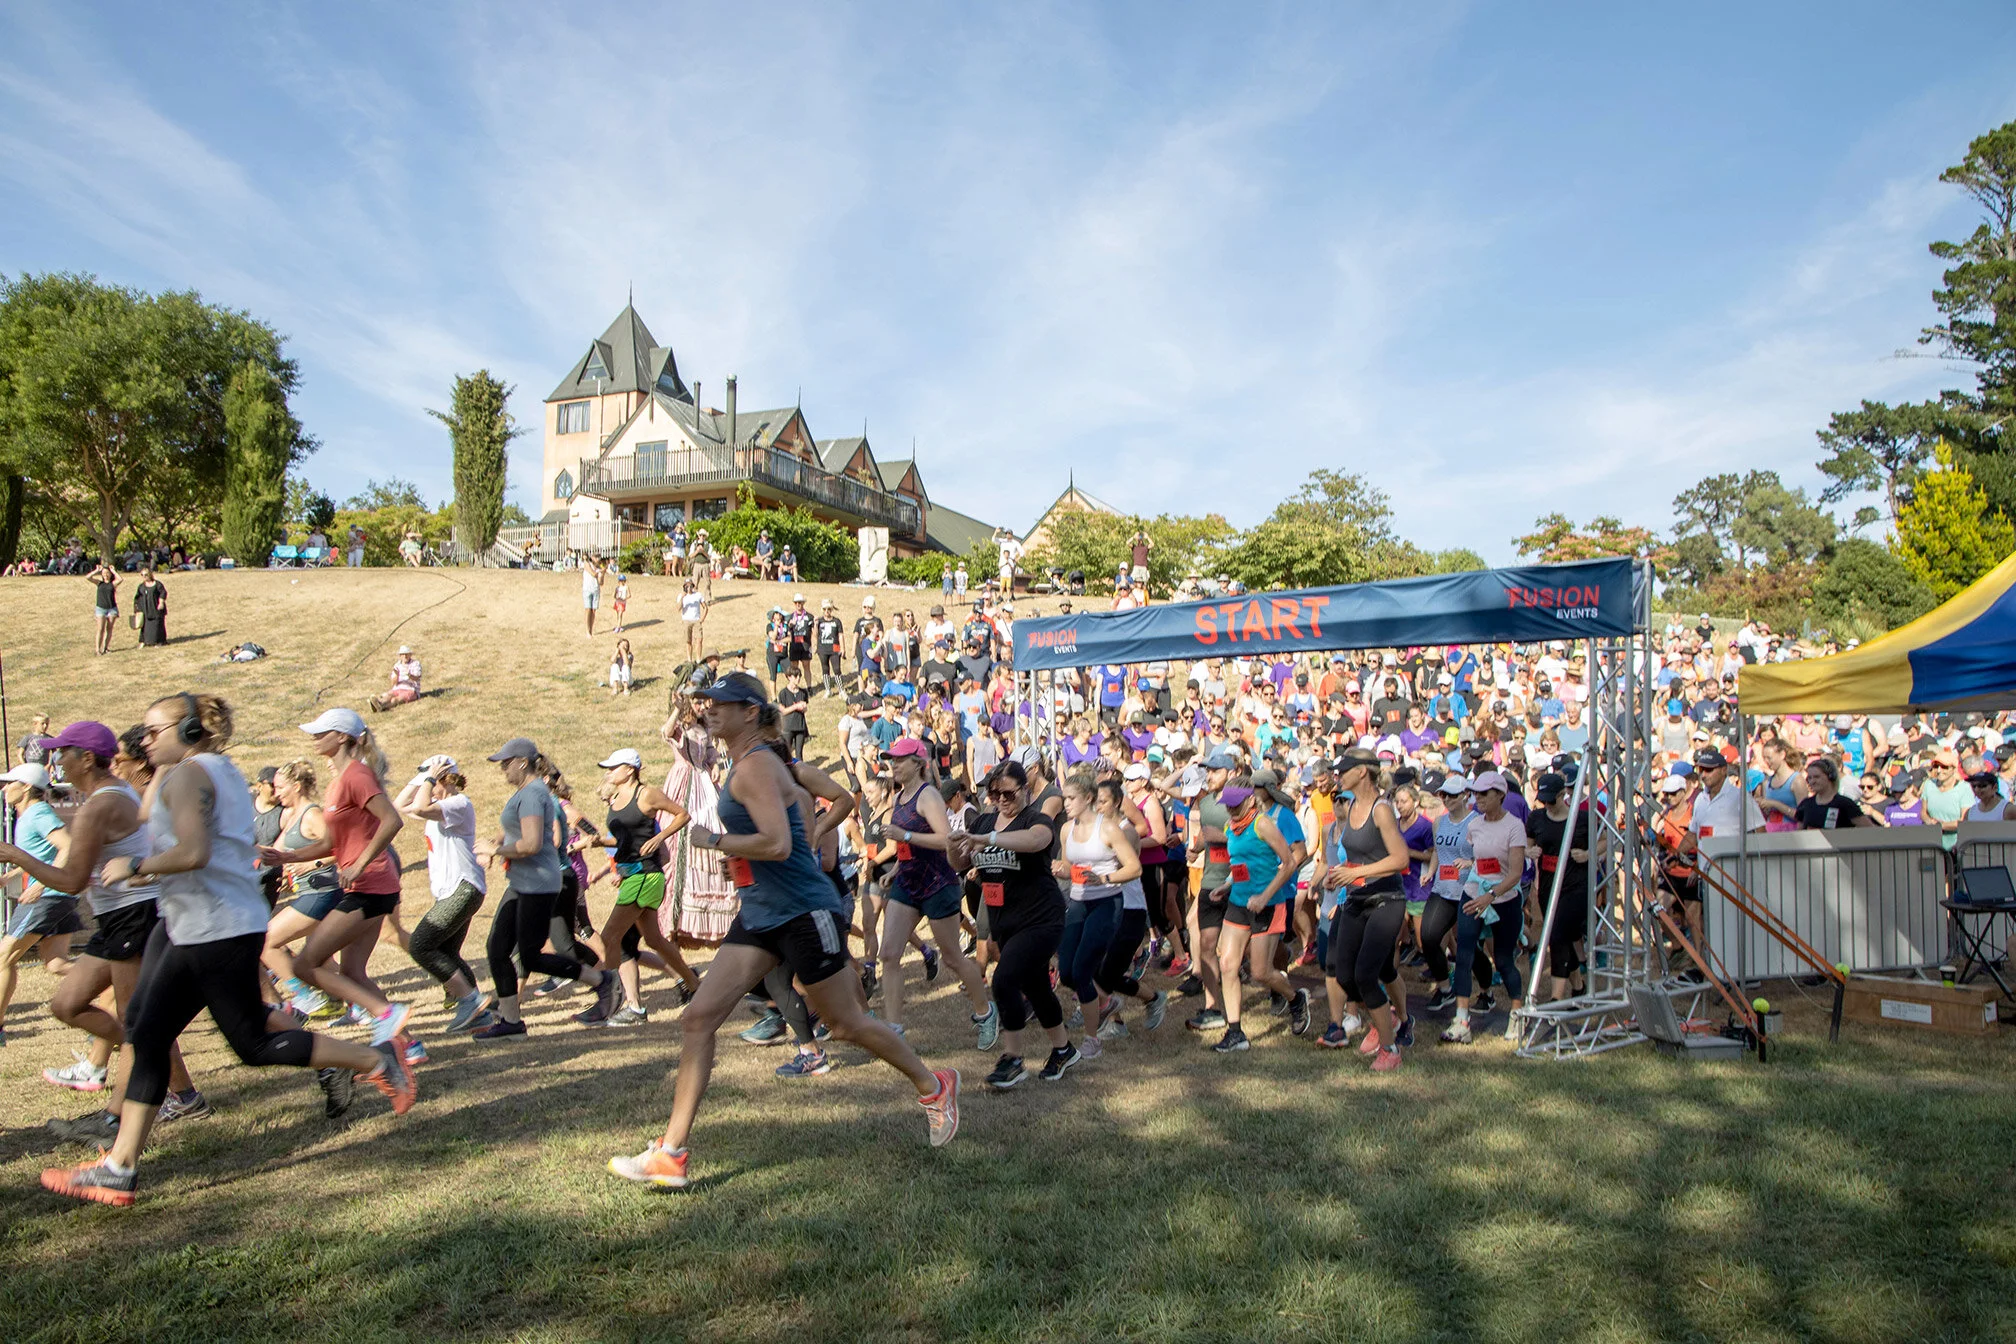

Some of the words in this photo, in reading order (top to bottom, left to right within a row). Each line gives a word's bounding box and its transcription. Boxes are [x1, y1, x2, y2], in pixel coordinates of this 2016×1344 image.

[1504, 585, 1600, 609] FUSION
[1194, 596, 1330, 645] START
[1556, 607, 1598, 619] EVENTS
[1027, 628, 1077, 649] FUSION
[1054, 645, 1077, 654] EVENTS
[1436, 832, 1461, 846] oui
[973, 850, 1017, 867] NSDALE
